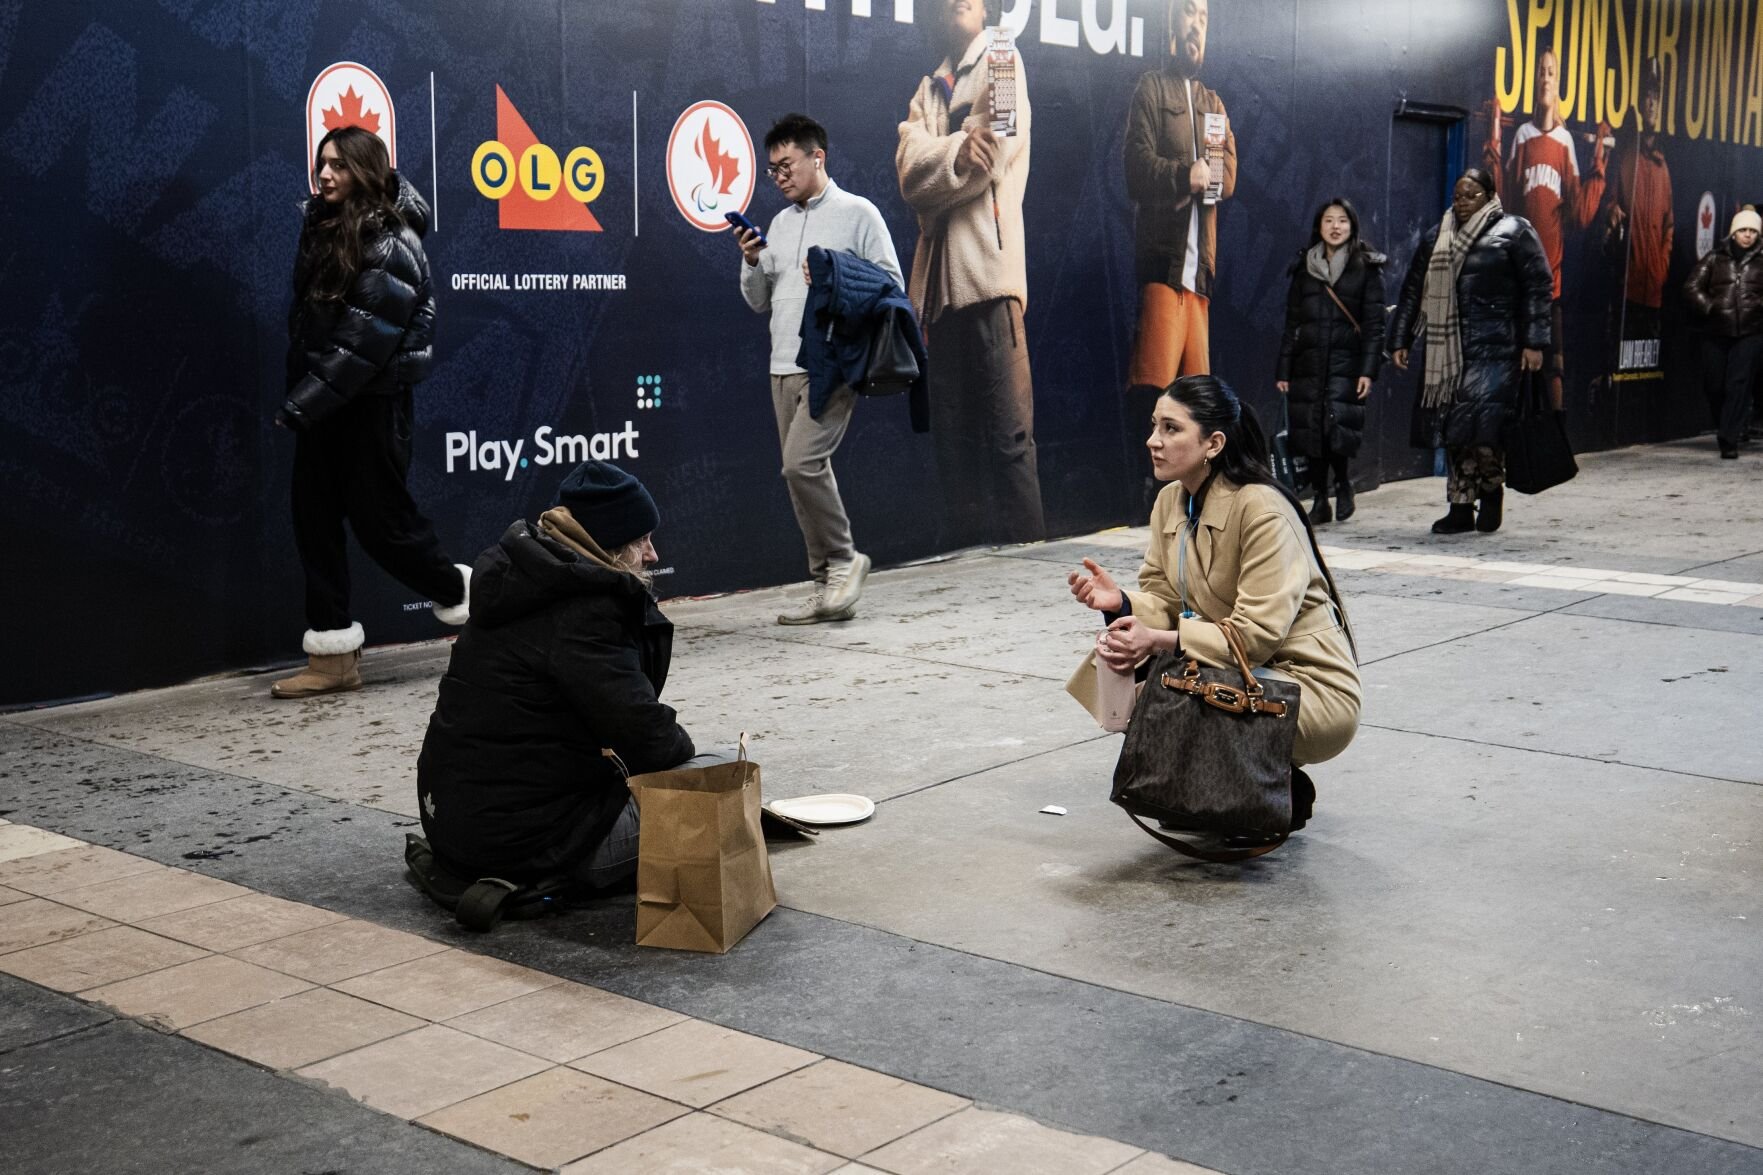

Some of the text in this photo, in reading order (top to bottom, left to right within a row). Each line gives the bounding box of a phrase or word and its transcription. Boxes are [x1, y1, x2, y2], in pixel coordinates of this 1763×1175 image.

[480, 151, 598, 192] OLG
[452, 273, 627, 291] OFFICIAL LOTTERY PARTNER
[446, 420, 640, 481] Play. Smart
[402, 602, 423, 612] TICKET
